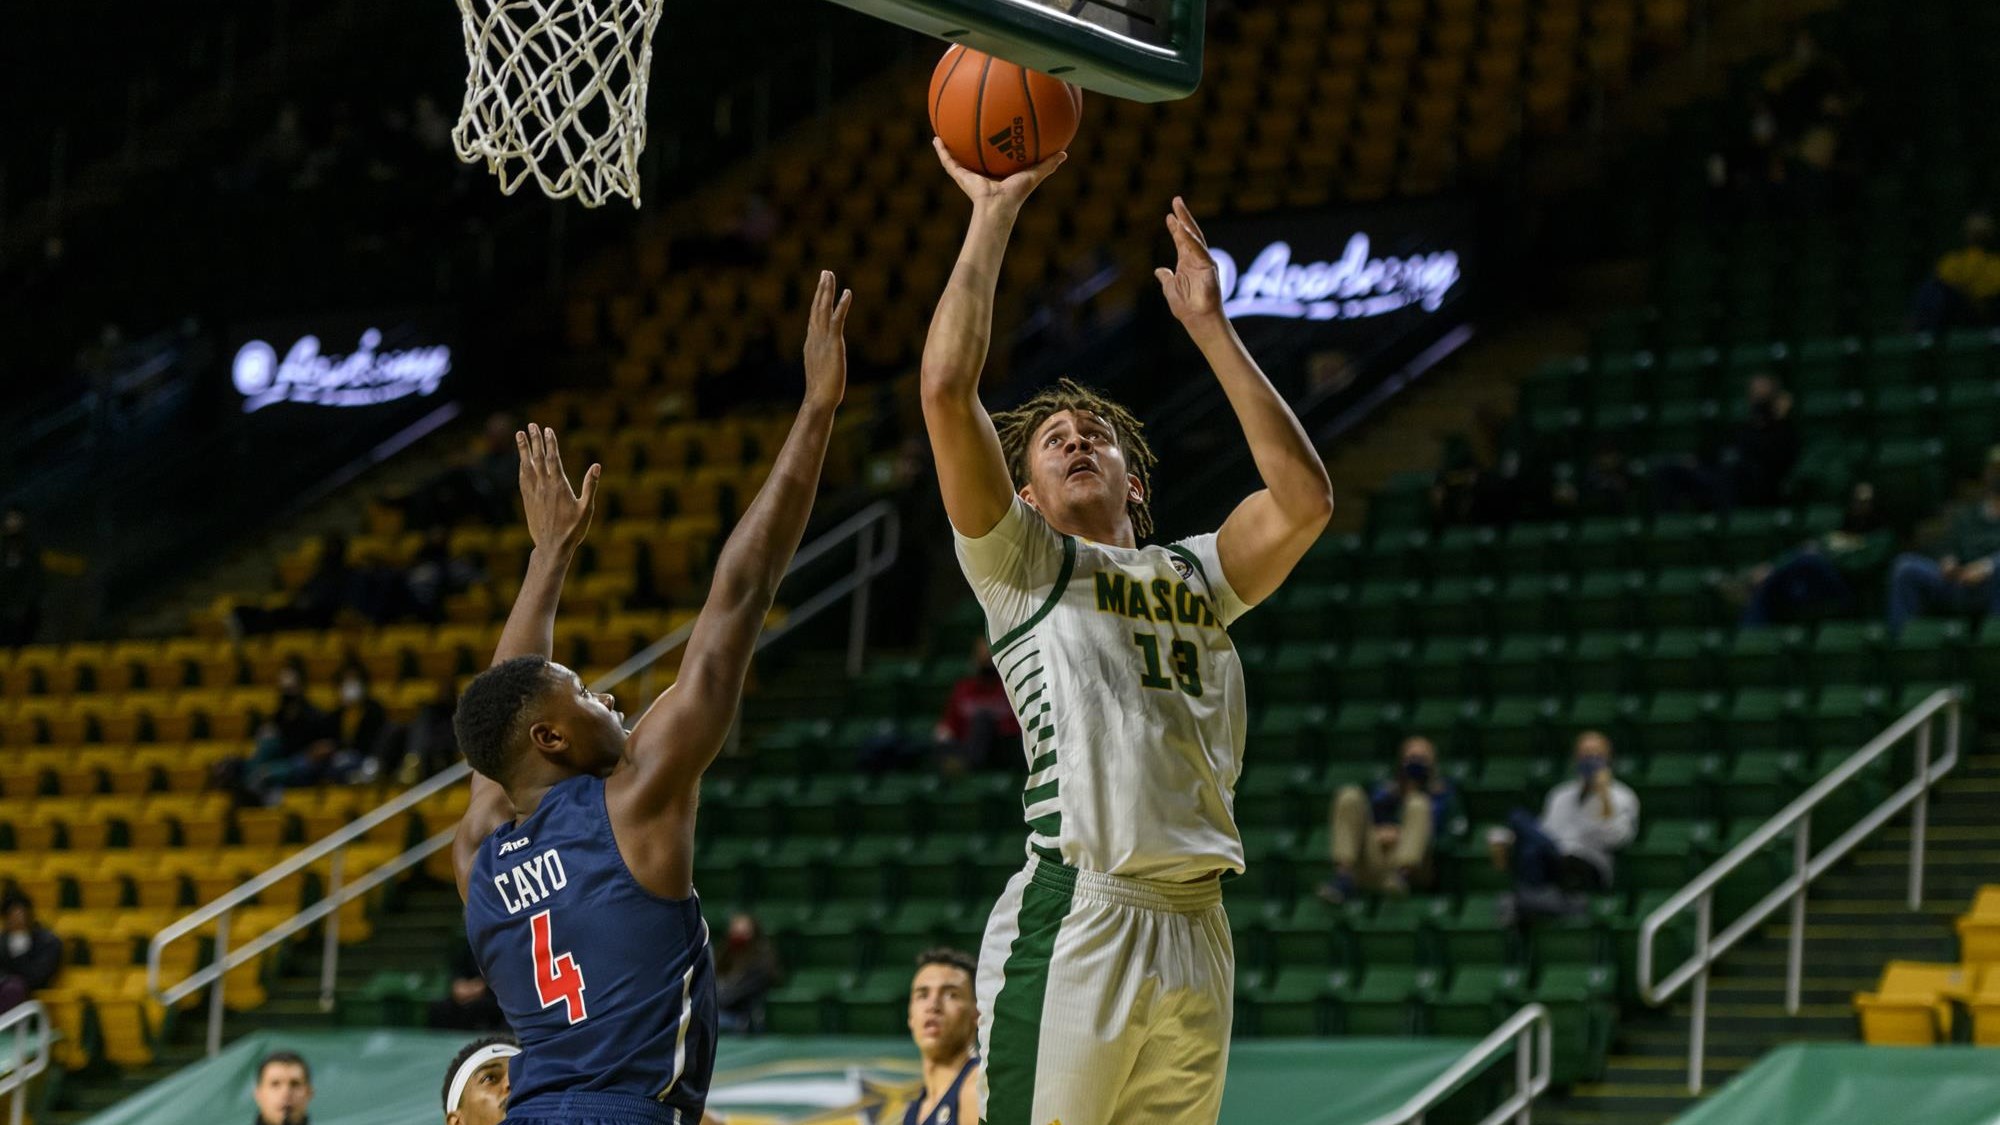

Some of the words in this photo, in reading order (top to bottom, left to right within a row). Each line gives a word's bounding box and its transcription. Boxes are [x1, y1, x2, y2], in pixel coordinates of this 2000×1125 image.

[1011, 115, 1026, 163] adidas
[1133, 632, 1203, 698] 13
[494, 848, 567, 915] CAYO
[530, 908, 588, 1025] 4
